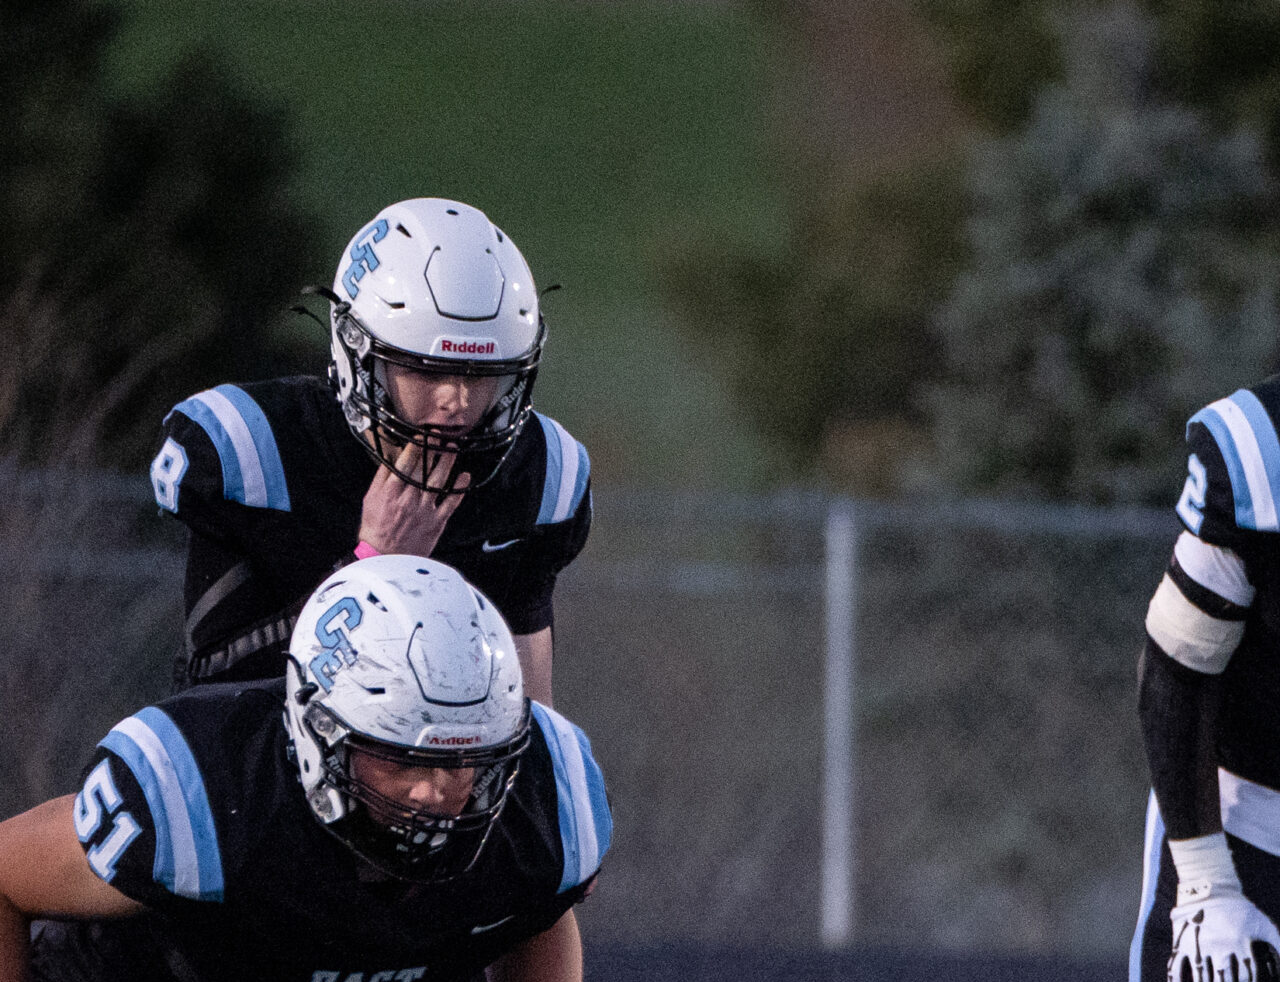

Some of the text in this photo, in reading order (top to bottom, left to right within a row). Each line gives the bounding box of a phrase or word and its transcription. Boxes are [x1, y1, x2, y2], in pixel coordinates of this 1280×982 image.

[441, 339, 495, 354] Riddell
[150, 437, 190, 514] 8
[1176, 453, 1209, 535] 2
[74, 758, 143, 883] 51
